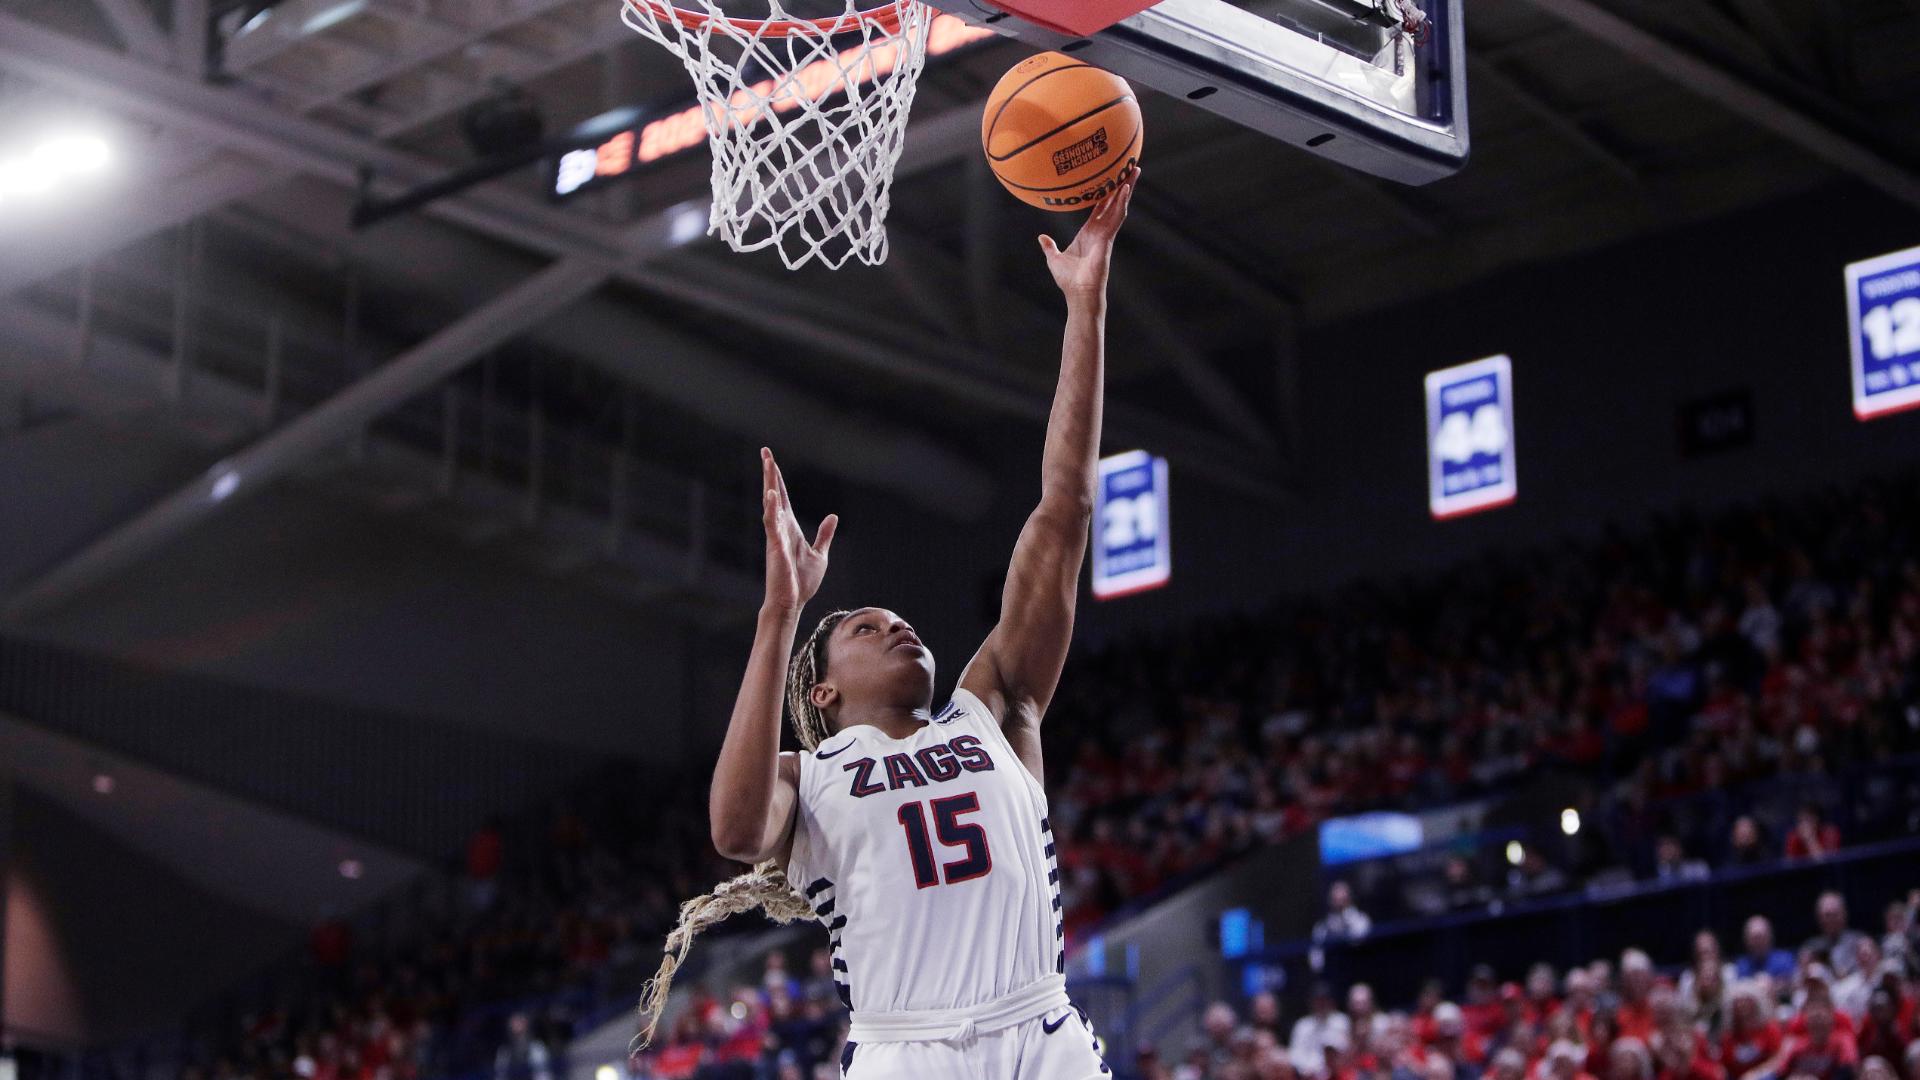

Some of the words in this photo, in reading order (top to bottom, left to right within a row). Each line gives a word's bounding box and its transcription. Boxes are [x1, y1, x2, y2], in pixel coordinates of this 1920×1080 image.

[1053, 140, 1094, 165] MADNESS
[1070, 146, 1100, 168] MARCH
[1434, 404, 1508, 464] 44
[1102, 491, 1157, 548] 21
[843, 735, 995, 798] ZAGS
[897, 791, 993, 890] 15
